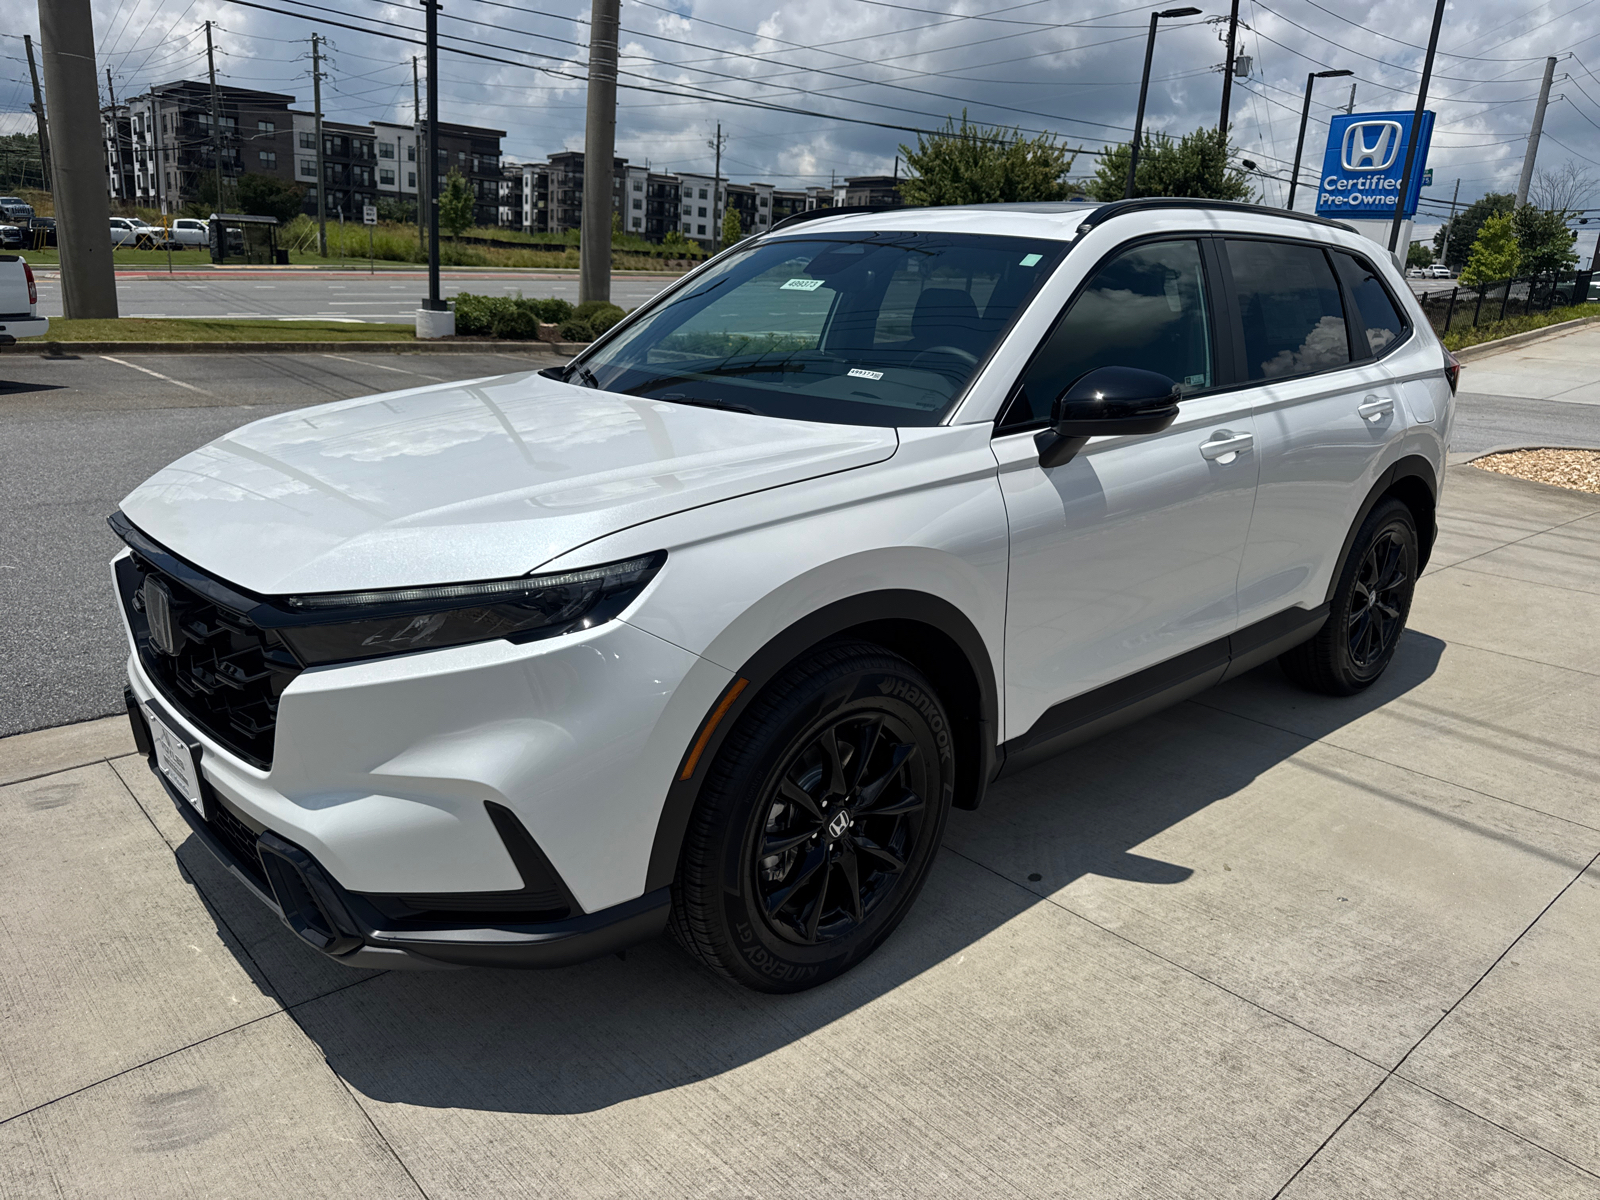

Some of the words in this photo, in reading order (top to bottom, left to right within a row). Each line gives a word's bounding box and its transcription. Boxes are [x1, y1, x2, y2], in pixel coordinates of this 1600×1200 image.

[1320, 193, 1400, 205] Pre-Owne
[736, 922, 754, 943] GT
[743, 944, 820, 982] KINERGY
